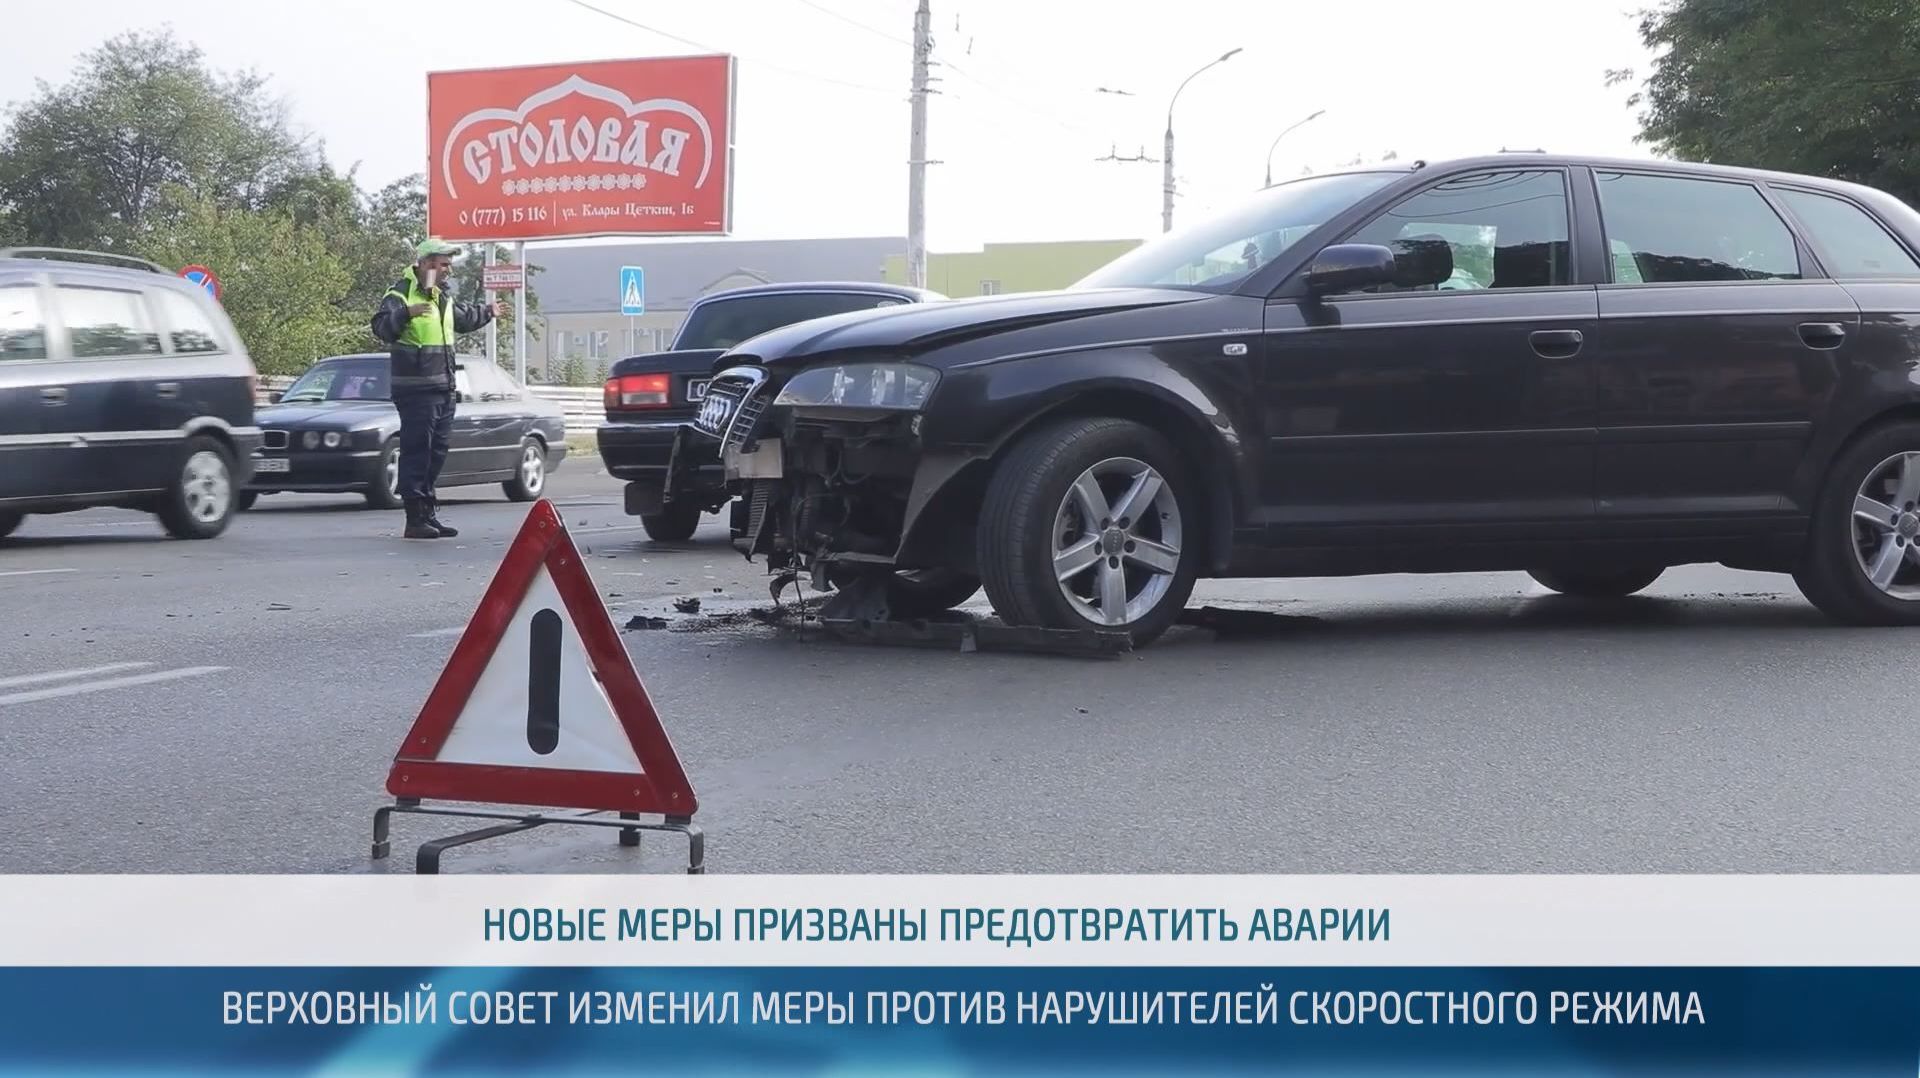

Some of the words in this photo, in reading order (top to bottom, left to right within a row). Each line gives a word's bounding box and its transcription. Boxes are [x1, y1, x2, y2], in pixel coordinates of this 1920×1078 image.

[463, 114, 690, 185] СТОЛОВАЯ
[459, 210, 468, 225] 0
[472, 206, 506, 227] (777)
[512, 207, 523, 222] 15
[528, 206, 547, 221] 116
[562, 208, 577, 221] ул.
[582, 203, 620, 219] Клары
[625, 202, 676, 218] Цеткин,
